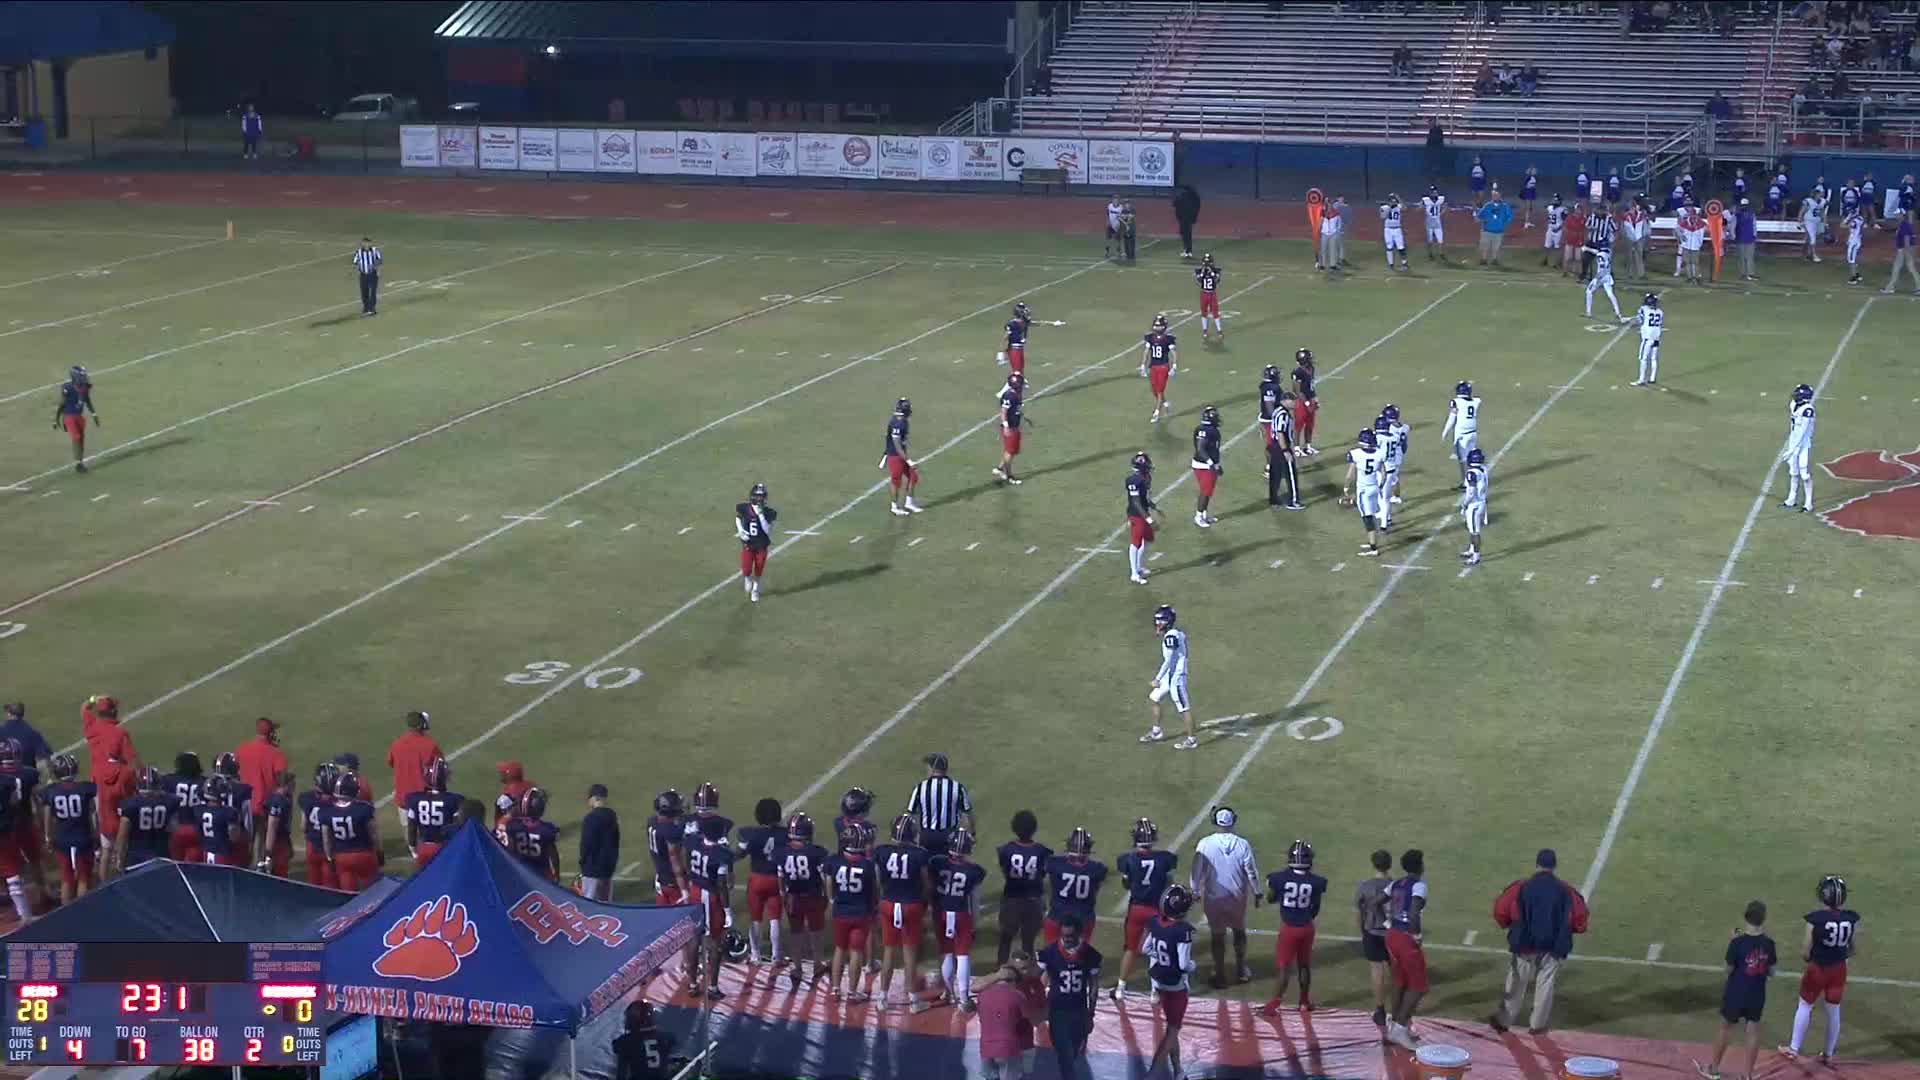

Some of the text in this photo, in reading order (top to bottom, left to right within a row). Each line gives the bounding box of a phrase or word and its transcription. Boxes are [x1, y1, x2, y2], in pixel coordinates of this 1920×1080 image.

[1203, 278, 1213, 289] 12
[1648, 313, 1661, 327] 22
[1151, 345, 1162, 358] 18
[1466, 406, 1475, 419] 9
[1386, 441, 1397, 458] 15
[1364, 459, 1374, 475] 5
[749, 522, 758, 536] 6
[504, 660, 643, 689] 30
[54, 794, 82, 819] 90
[139, 806, 167, 830] 60
[418, 801, 444, 826] 85
[202, 812, 214, 838] 2
[331, 817, 356, 841] 51
[516, 833, 542, 857] 25
[648, 826, 658, 854] 11
[763, 837, 775, 861] 4
[690, 849, 709, 878] 21
[784, 855, 810, 881] 48
[886, 852, 909, 880] 41
[1010, 854, 1038, 880] 84
[1141, 860, 1155, 885] 7
[834, 865, 864, 893] 45
[937, 872, 967, 897] 32
[1058, 873, 1091, 898] 70
[1283, 882, 1313, 909] 28
[1823, 921, 1850, 948] 30
[1059, 970, 1083, 994] 35
[413, 991, 464, 1024] PATH
[468, 999, 533, 1029] BEARS
[645, 1039, 660, 1068] 5
